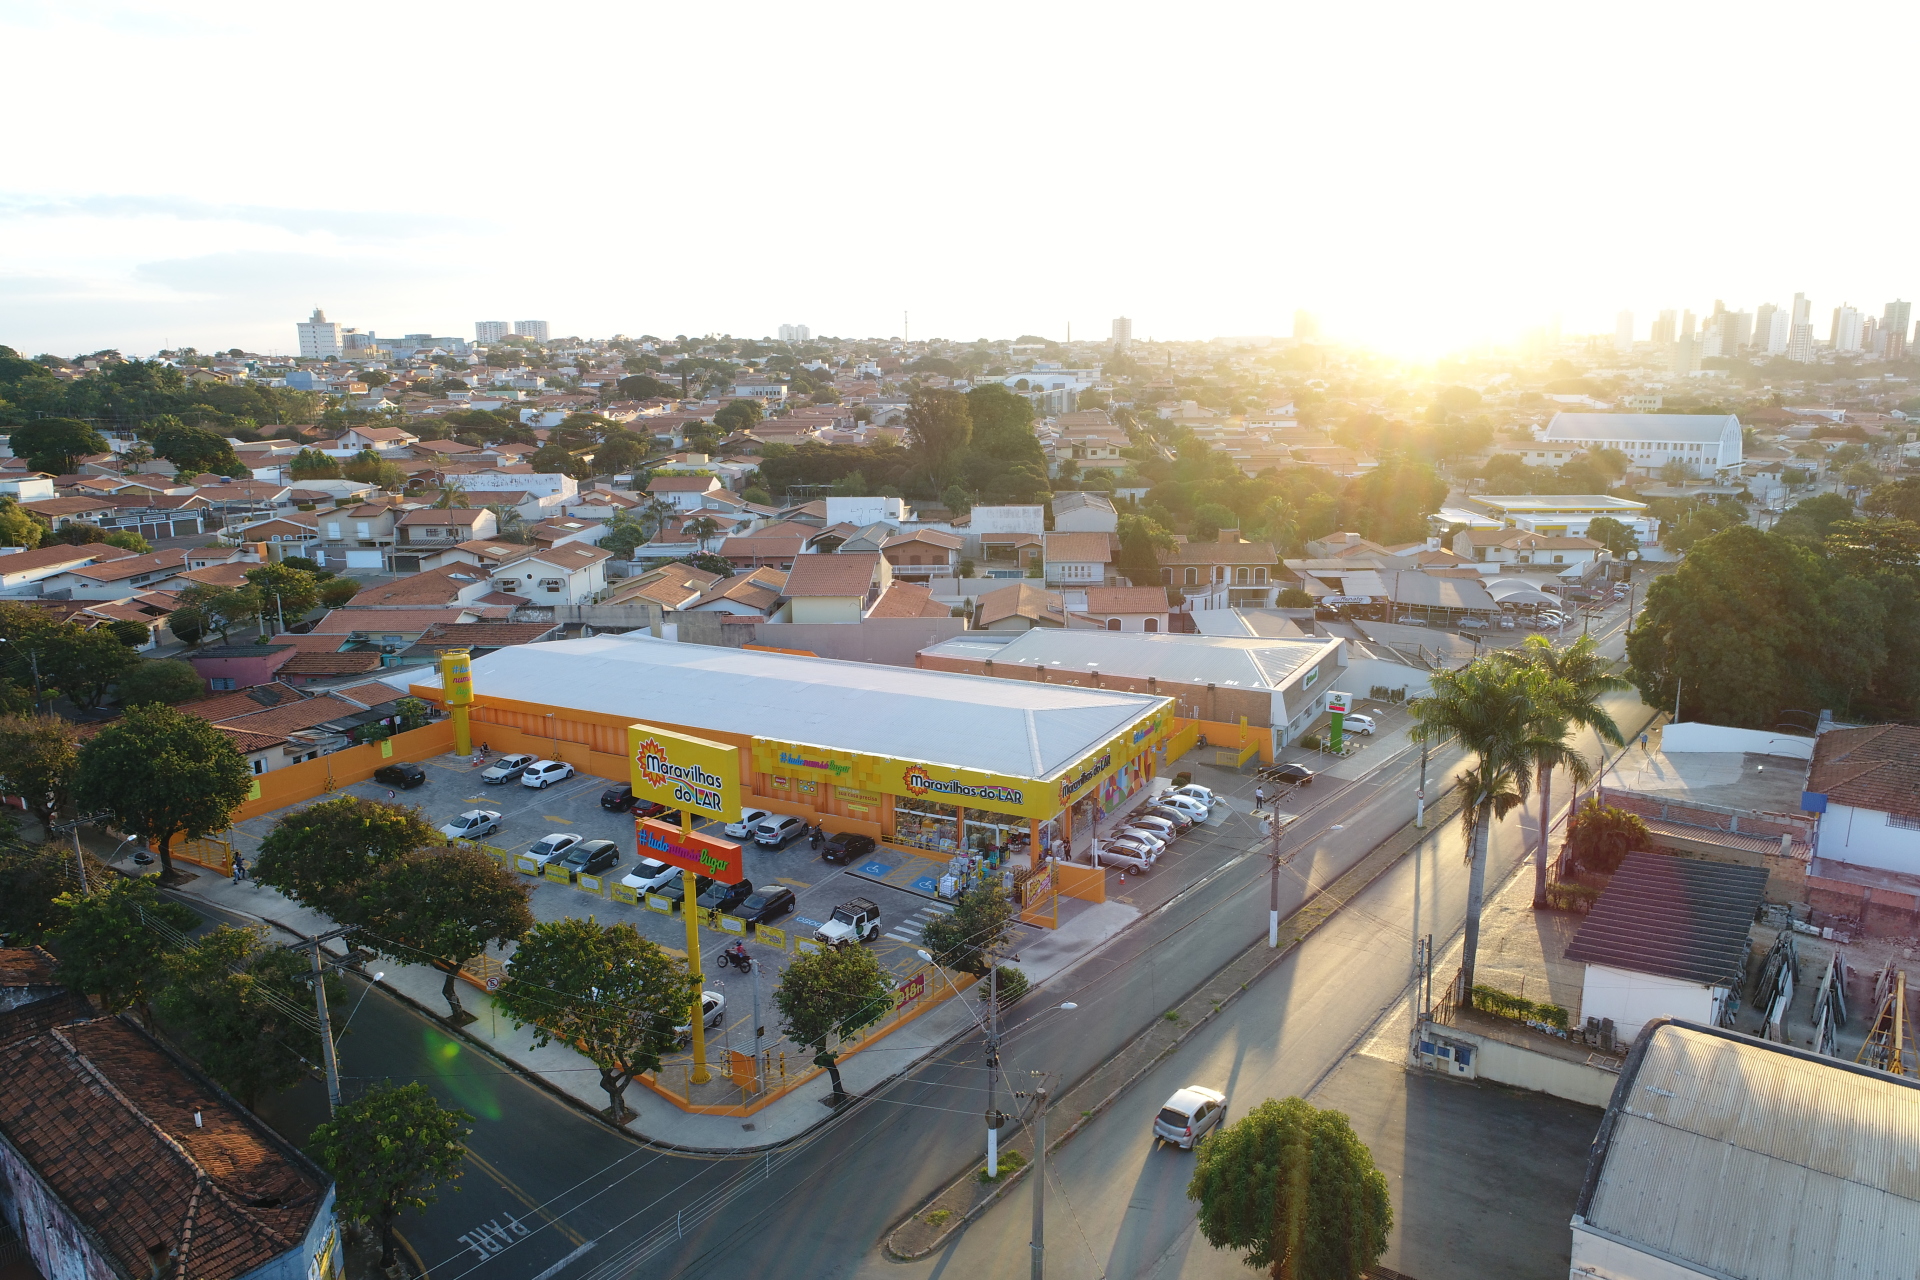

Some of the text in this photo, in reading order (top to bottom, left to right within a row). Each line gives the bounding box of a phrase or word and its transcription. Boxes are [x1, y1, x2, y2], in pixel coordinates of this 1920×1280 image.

[646, 753, 722, 790] Maravilhas
[674, 786, 723, 812] do LAR
[910, 774, 1024, 805] Maravilhas do LAR
[456, 1211, 531, 1262] PARE
